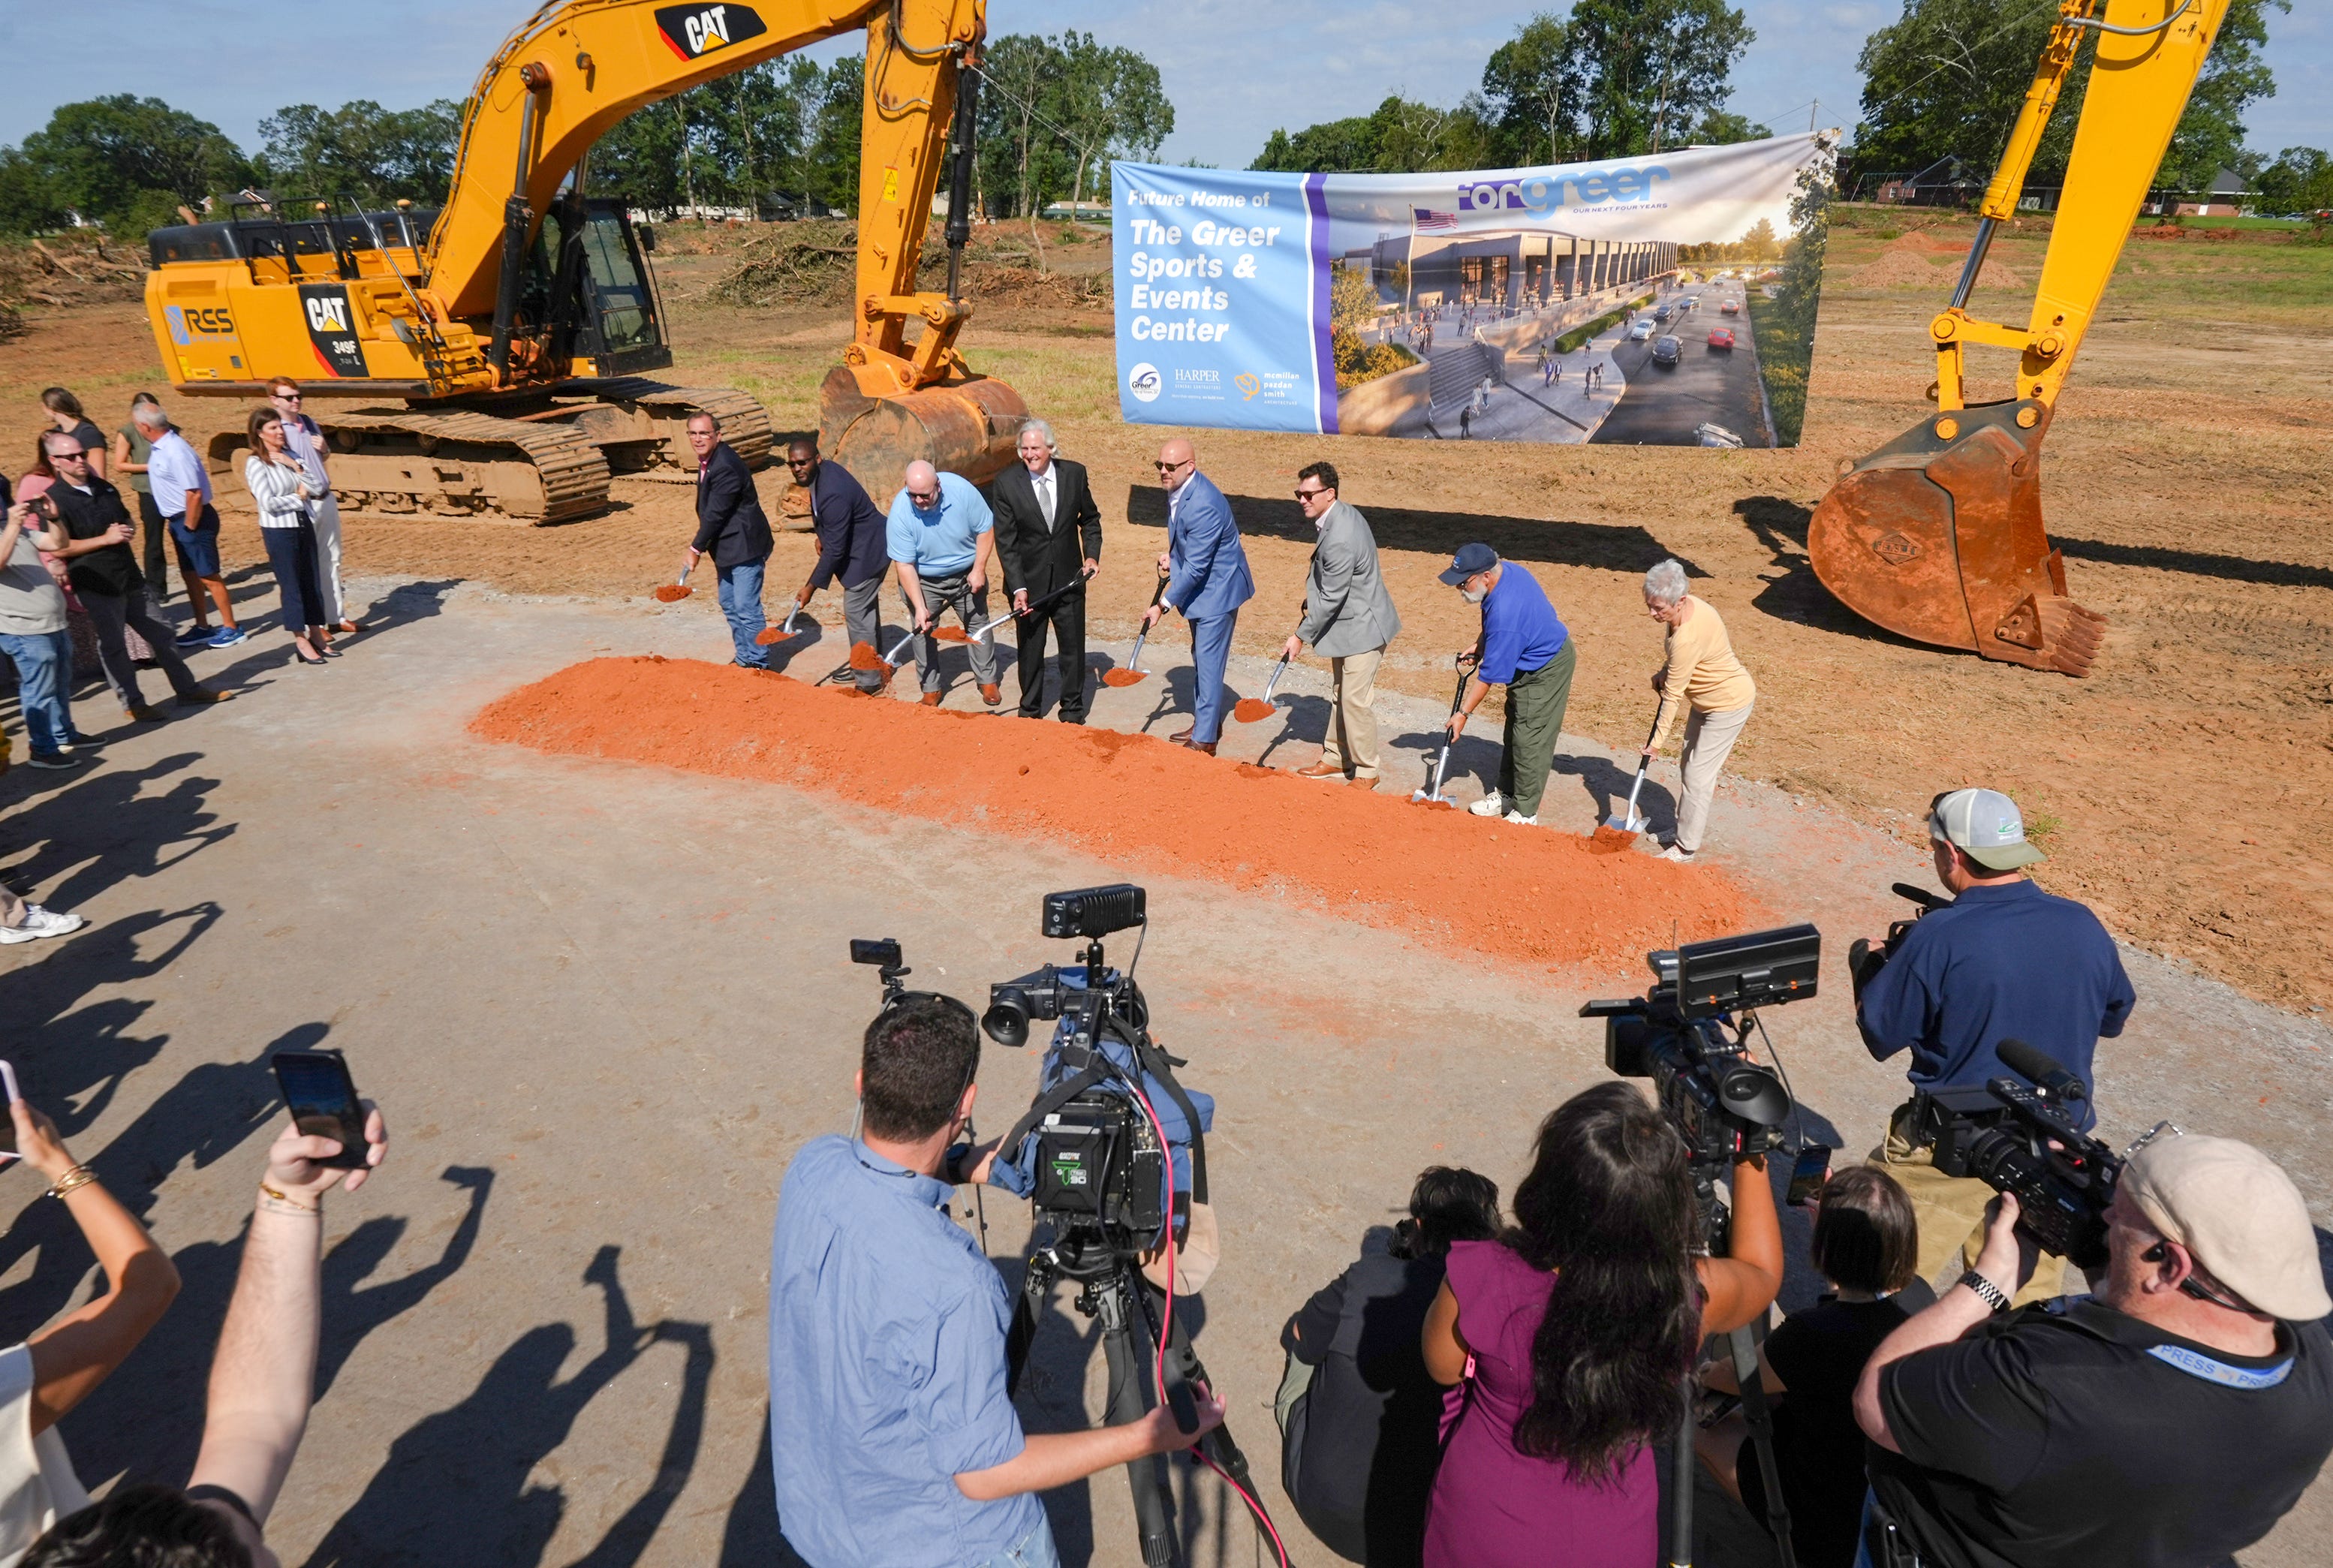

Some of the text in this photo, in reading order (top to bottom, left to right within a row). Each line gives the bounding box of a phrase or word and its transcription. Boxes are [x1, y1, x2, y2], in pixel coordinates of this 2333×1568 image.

[685, 5, 730, 54] CAT
[1128, 190, 1270, 207] Future Home of
[1130, 219, 1281, 246] The Greer
[1130, 251, 1258, 282] Sports &
[1130, 284, 1229, 311] Events
[184, 308, 234, 333] RSS
[306, 297, 348, 333] CAT
[1130, 315, 1230, 342] Center
[1175, 369, 1221, 382] HARPER
[1263, 381, 1293, 390] pazdan
[2160, 1344, 2217, 1374] PRESS
